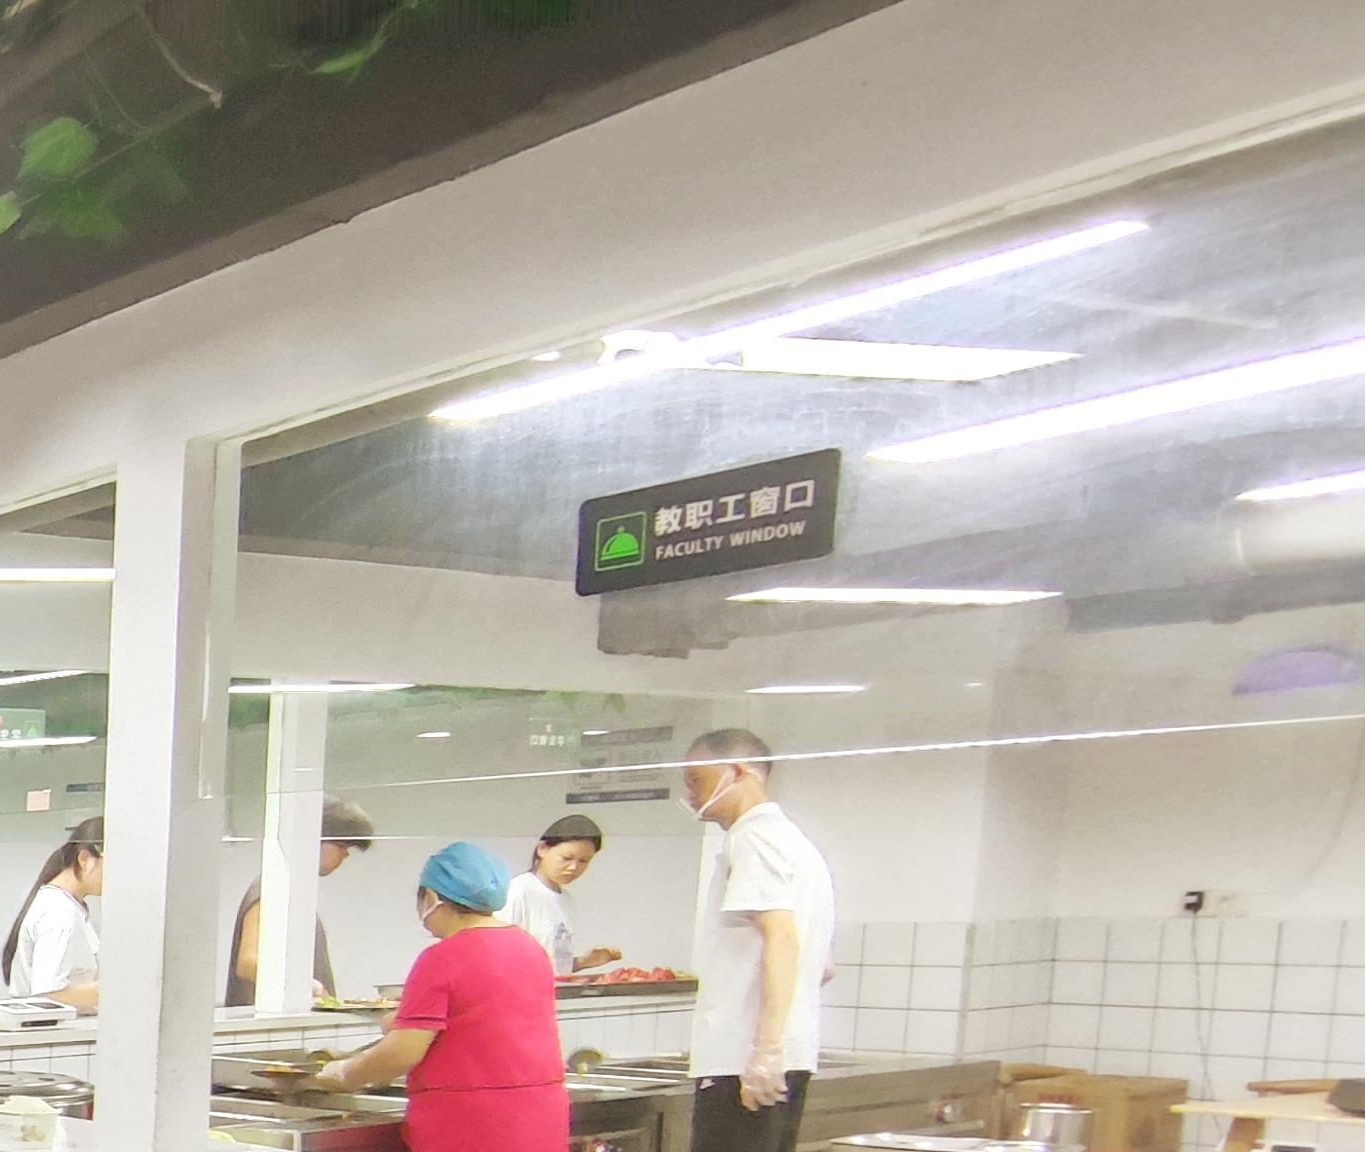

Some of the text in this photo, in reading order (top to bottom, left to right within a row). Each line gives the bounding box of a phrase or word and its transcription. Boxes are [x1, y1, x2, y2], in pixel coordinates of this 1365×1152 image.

[653, 479, 815, 536] 教职工窗口
[655, 520, 807, 560] FACULTY WINDOW
